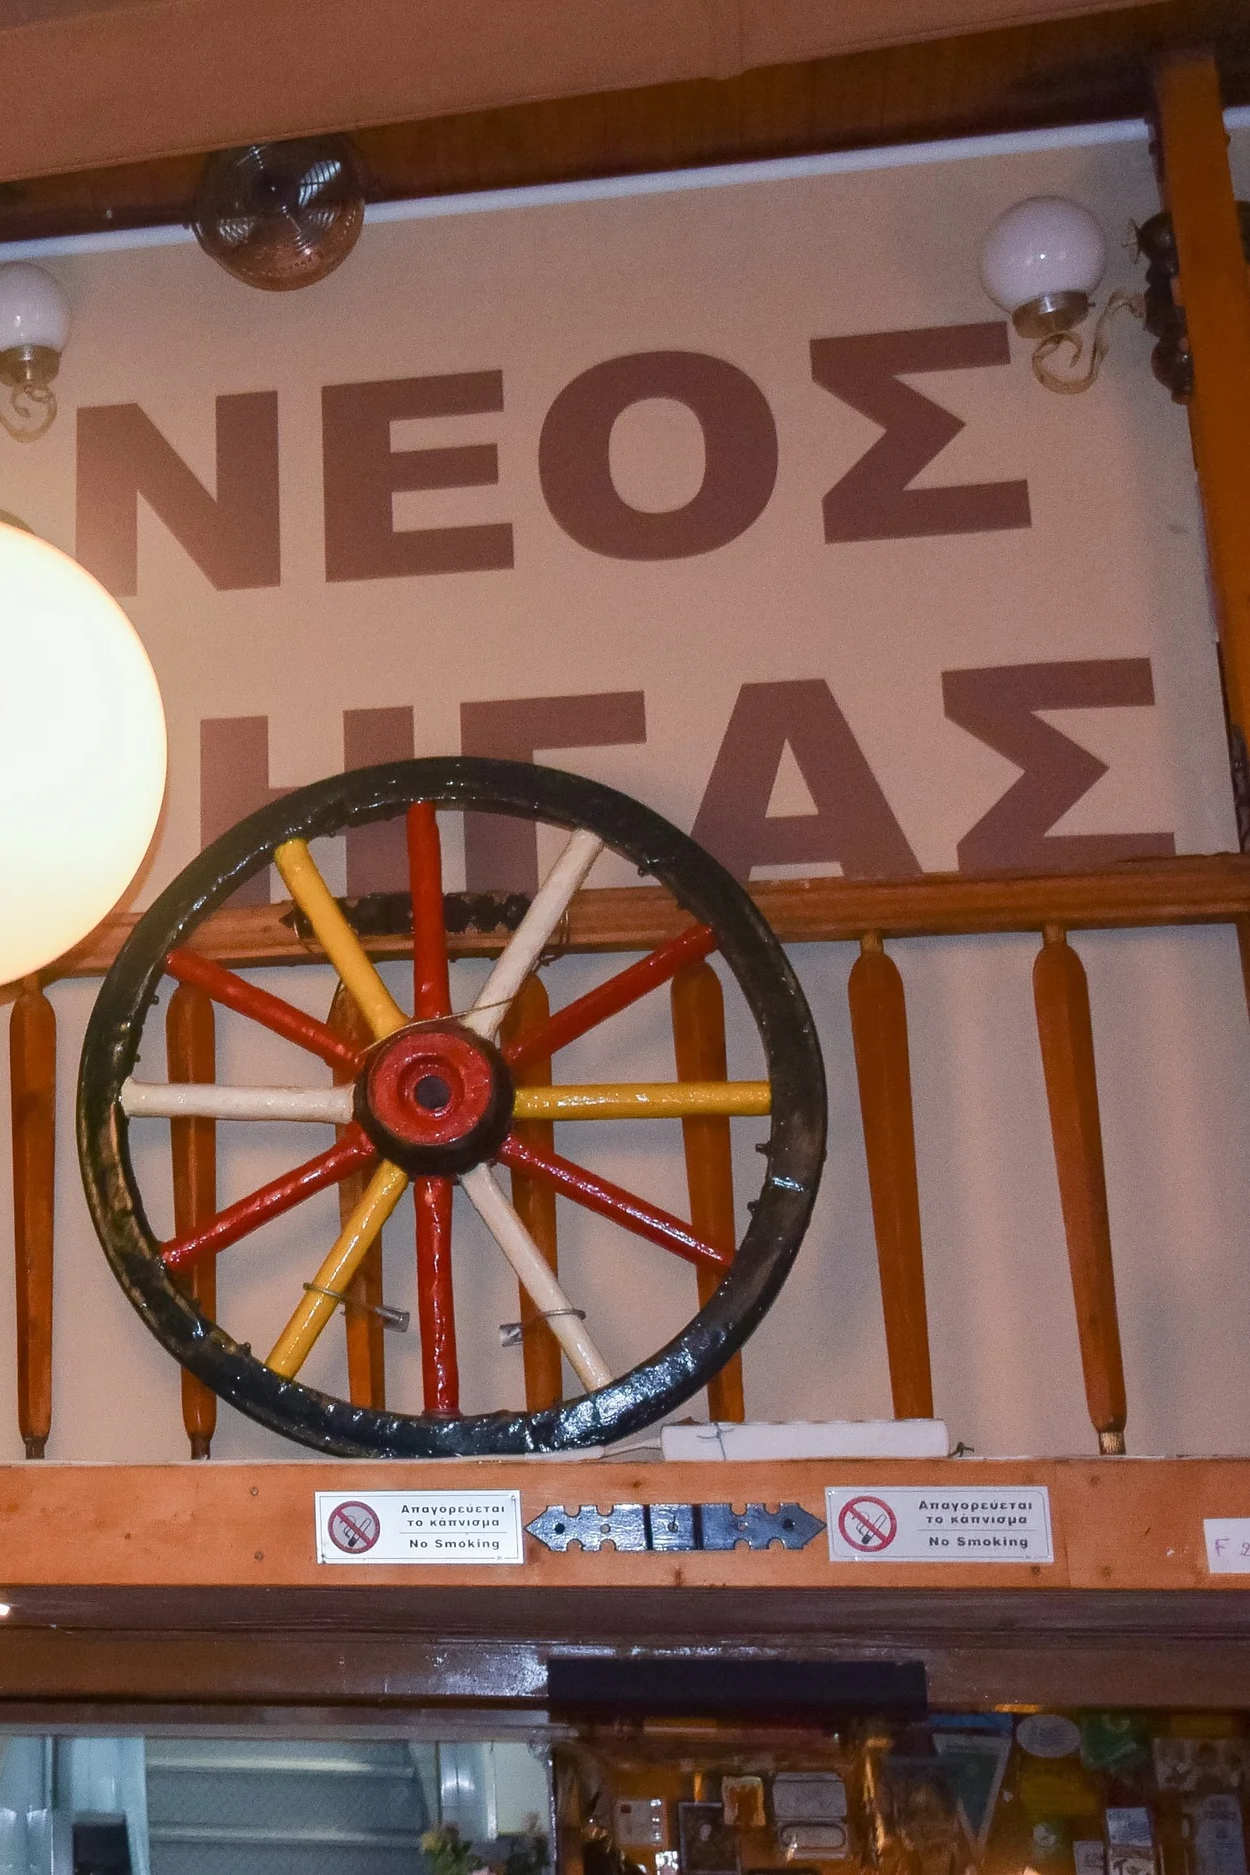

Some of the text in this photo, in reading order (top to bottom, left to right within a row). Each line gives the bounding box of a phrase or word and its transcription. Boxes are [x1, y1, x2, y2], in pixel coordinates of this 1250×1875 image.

[76, 321, 1031, 598] ΝΕΟΣ
[200, 657, 1176, 908] ΗΓΑΣ
[401, 1504, 505, 1517] Απαγορεύεται
[918, 1500, 1033, 1513] Απαγορεύεται
[407, 1517, 500, 1529] το κάπνισμα
[926, 1514, 1028, 1526] το κάπνισμα
[409, 1538, 500, 1550] No Smoking
[928, 1536, 1029, 1549] No Smoking
